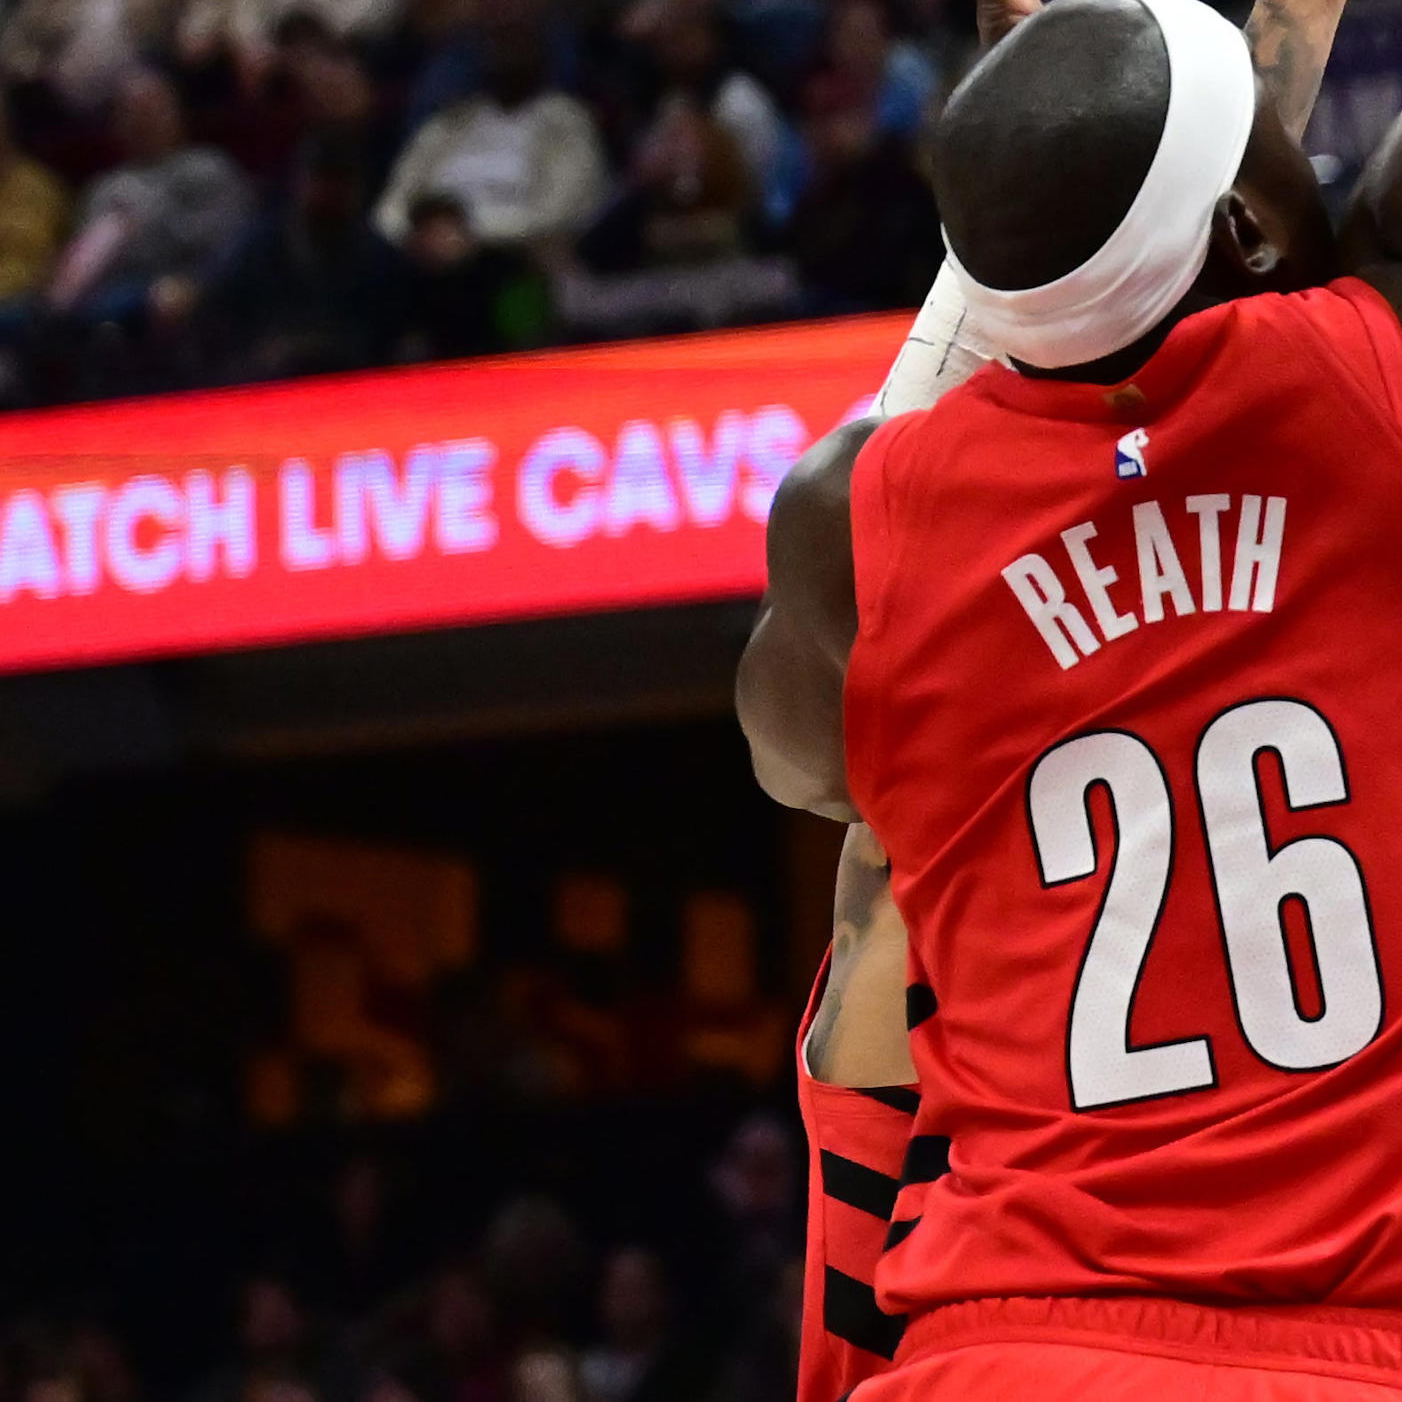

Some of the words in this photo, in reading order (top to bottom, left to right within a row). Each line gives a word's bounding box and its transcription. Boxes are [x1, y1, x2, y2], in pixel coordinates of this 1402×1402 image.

[0, 467, 257, 603] ATCH
[279, 435, 500, 571] LIVE
[516, 404, 812, 548] CAVS
[1000, 494, 1286, 671] REATH
[1025, 695, 1384, 1112] 26
